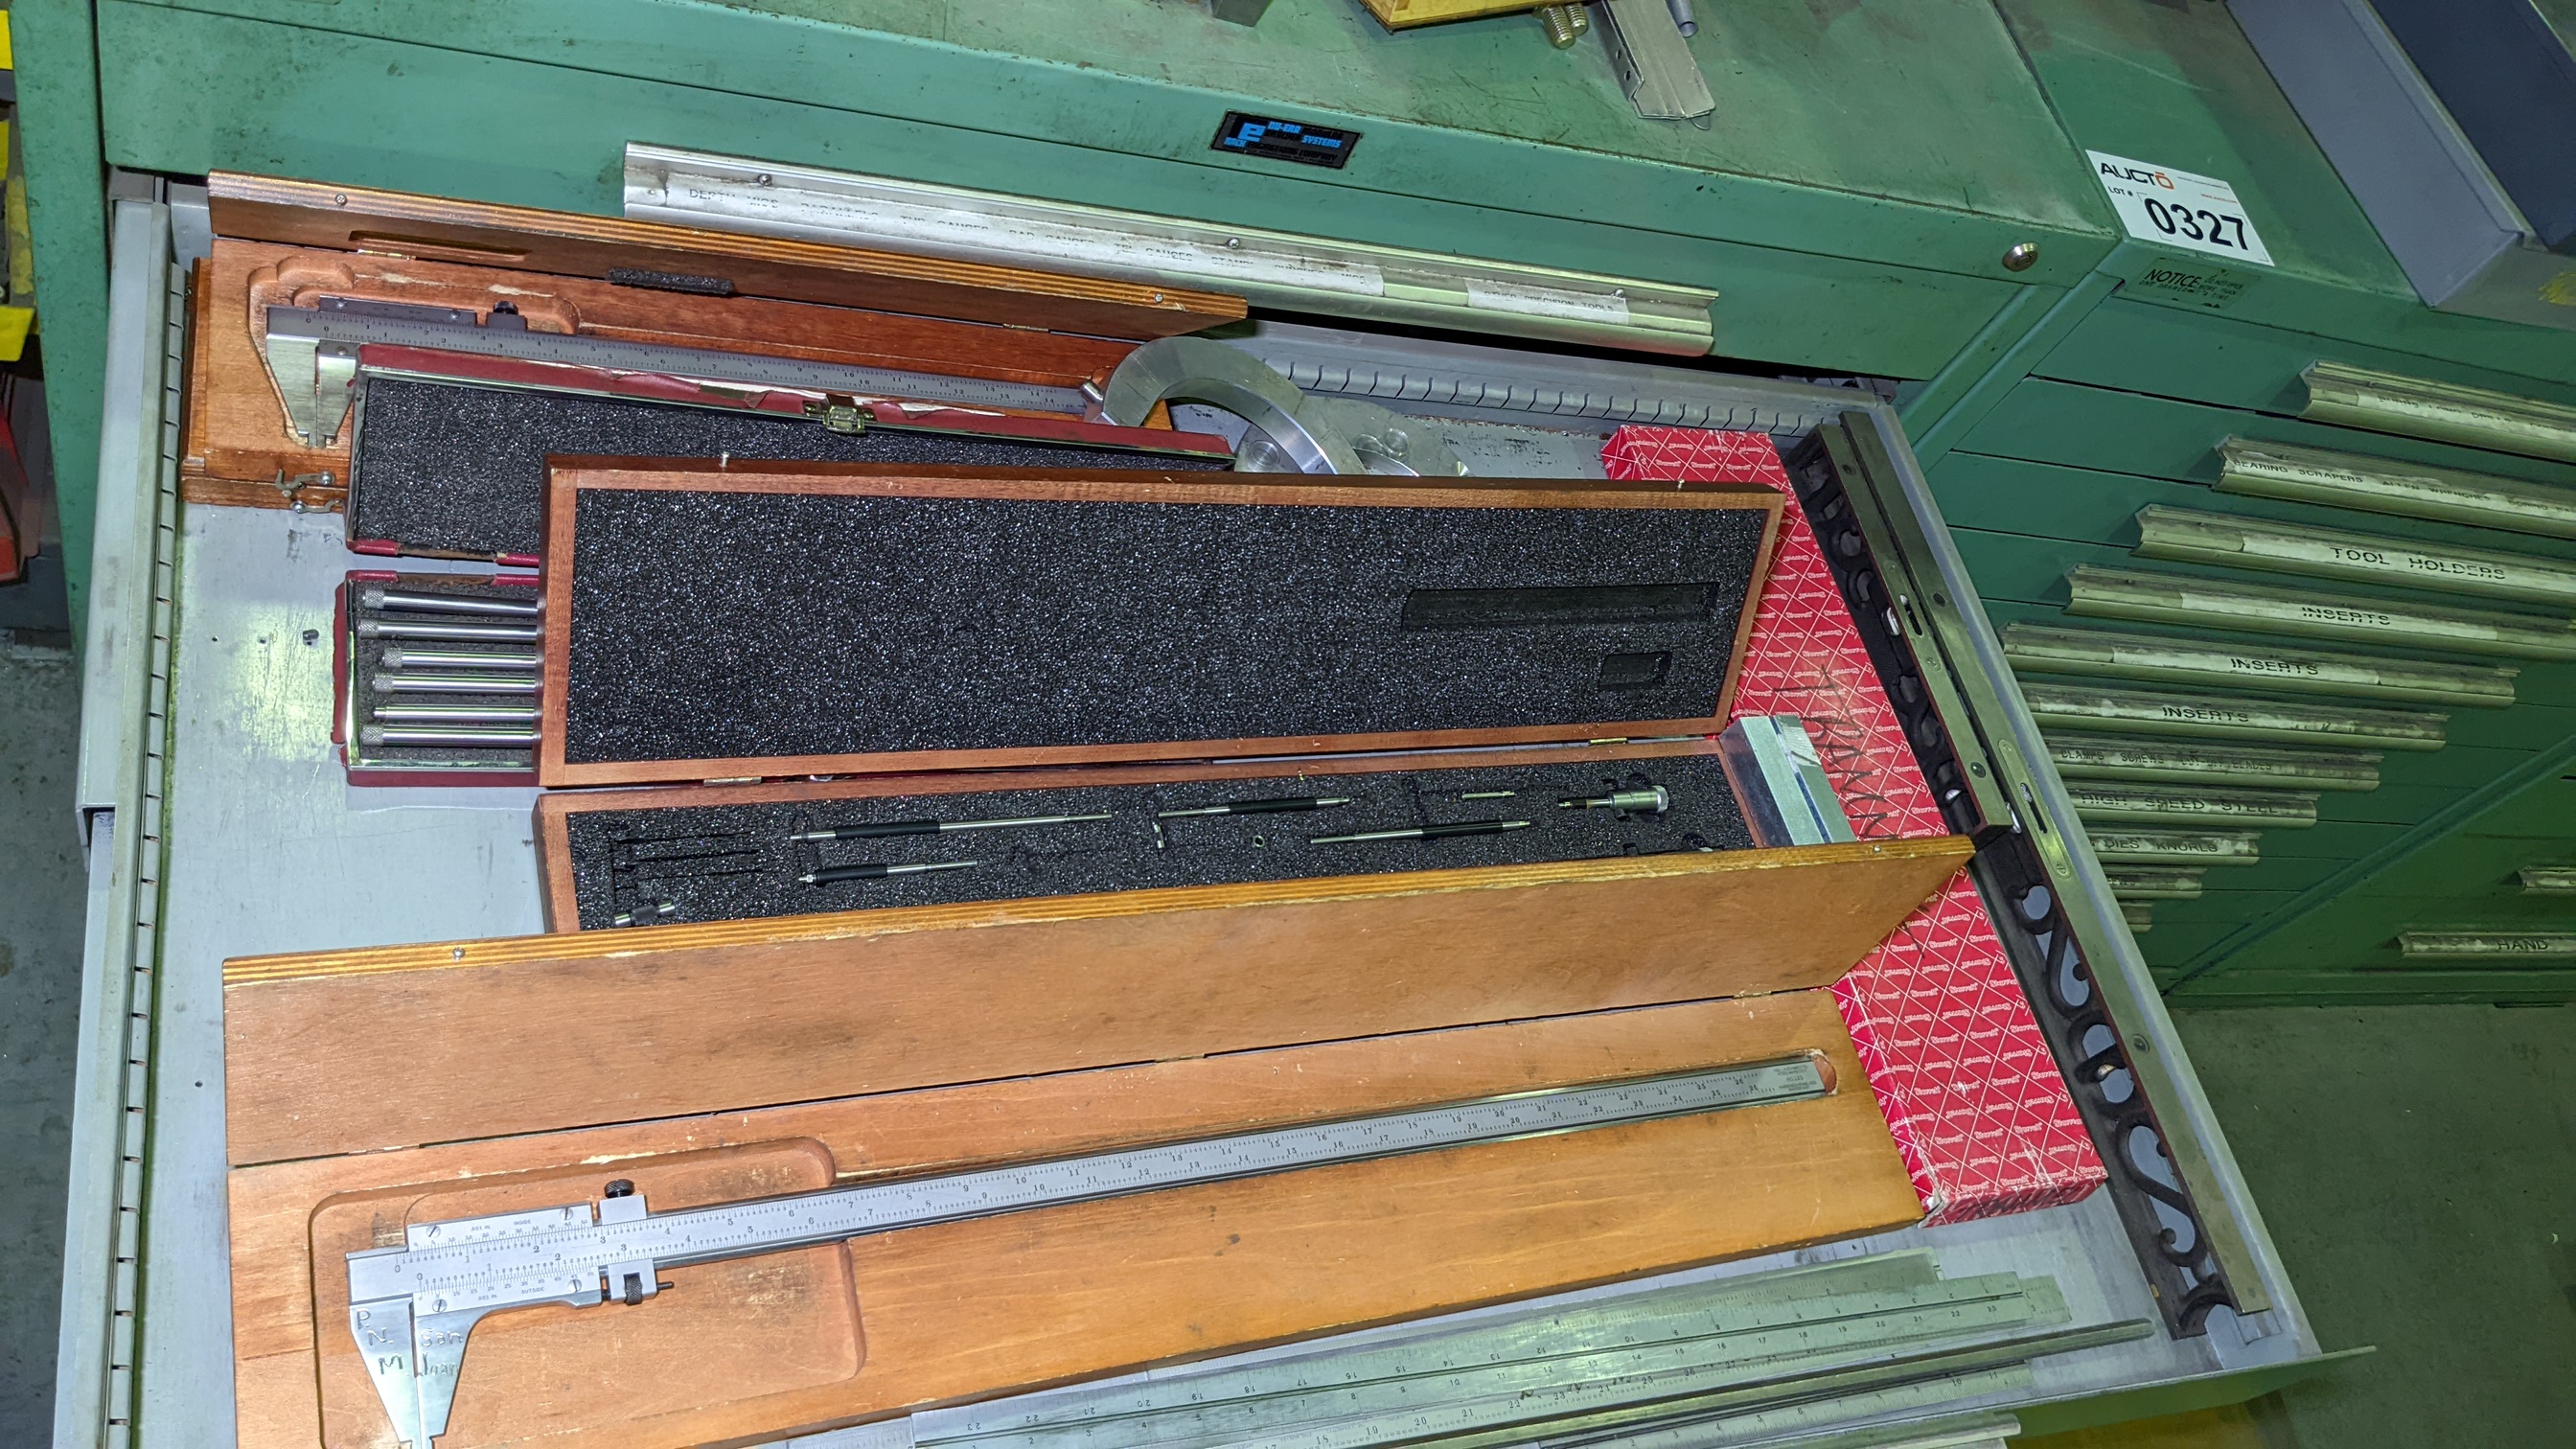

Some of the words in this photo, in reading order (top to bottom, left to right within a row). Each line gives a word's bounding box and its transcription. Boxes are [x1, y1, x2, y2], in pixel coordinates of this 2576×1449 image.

[1301, 134, 1342, 148] SYSTEMS
[2108, 186, 2126, 196] LOT
[2144, 197, 2248, 250] 0327
[2298, 469, 2363, 483] SCRAPERS
[2330, 546, 2390, 565] TOOL
[2408, 558, 2506, 581] HOLDERS
[2301, 606, 2390, 626] INSERTS
[2230, 657, 2319, 676] INSERTS
[2162, 706, 2250, 723] INSERTS
[2104, 840, 2140, 849] DIES
[2497, 939, 2548, 950] HAND
